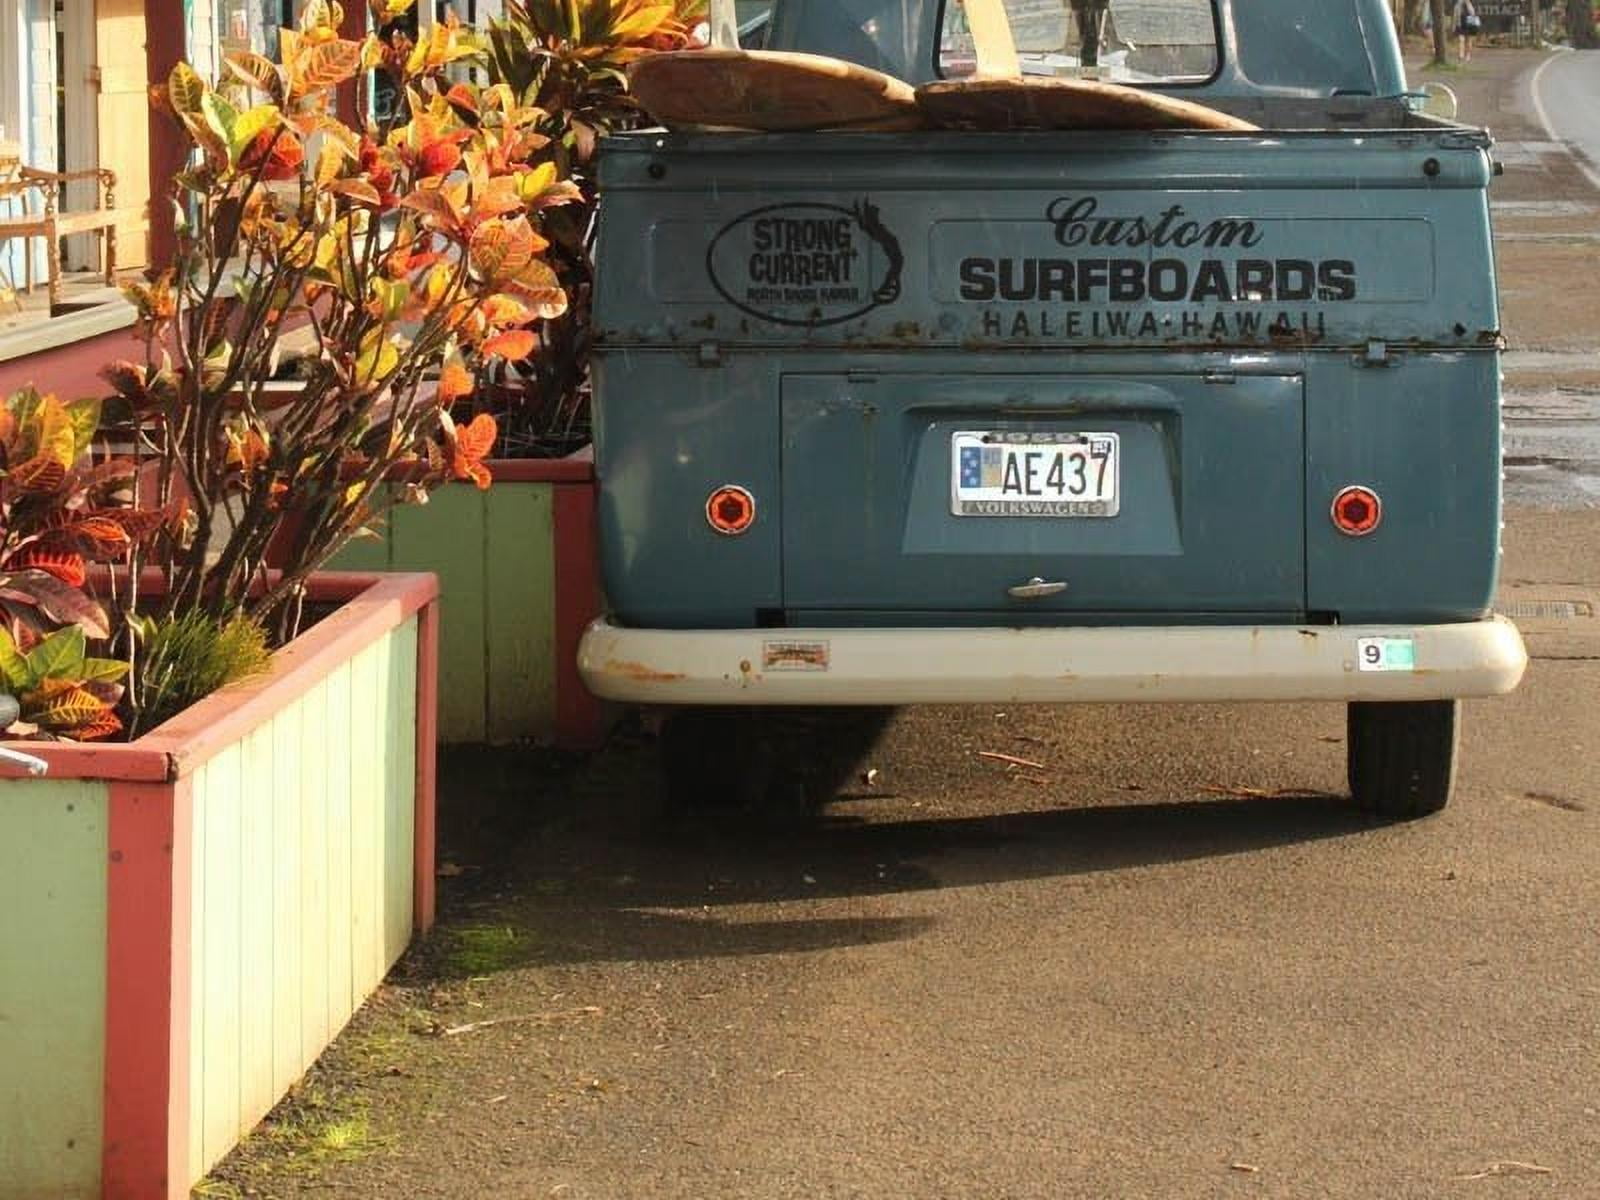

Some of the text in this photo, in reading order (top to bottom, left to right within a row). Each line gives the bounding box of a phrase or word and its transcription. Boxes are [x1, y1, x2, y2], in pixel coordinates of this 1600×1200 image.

[754, 218, 851, 252] STRONG
[1046, 197, 1264, 248] Custom
[749, 252, 851, 285] CURRENT
[959, 258, 1355, 302] SURFBOARDS
[1002, 449, 1111, 497] AE437
[975, 501, 1090, 514] VOLKSWAGEN
[1364, 644, 1381, 664] 9
